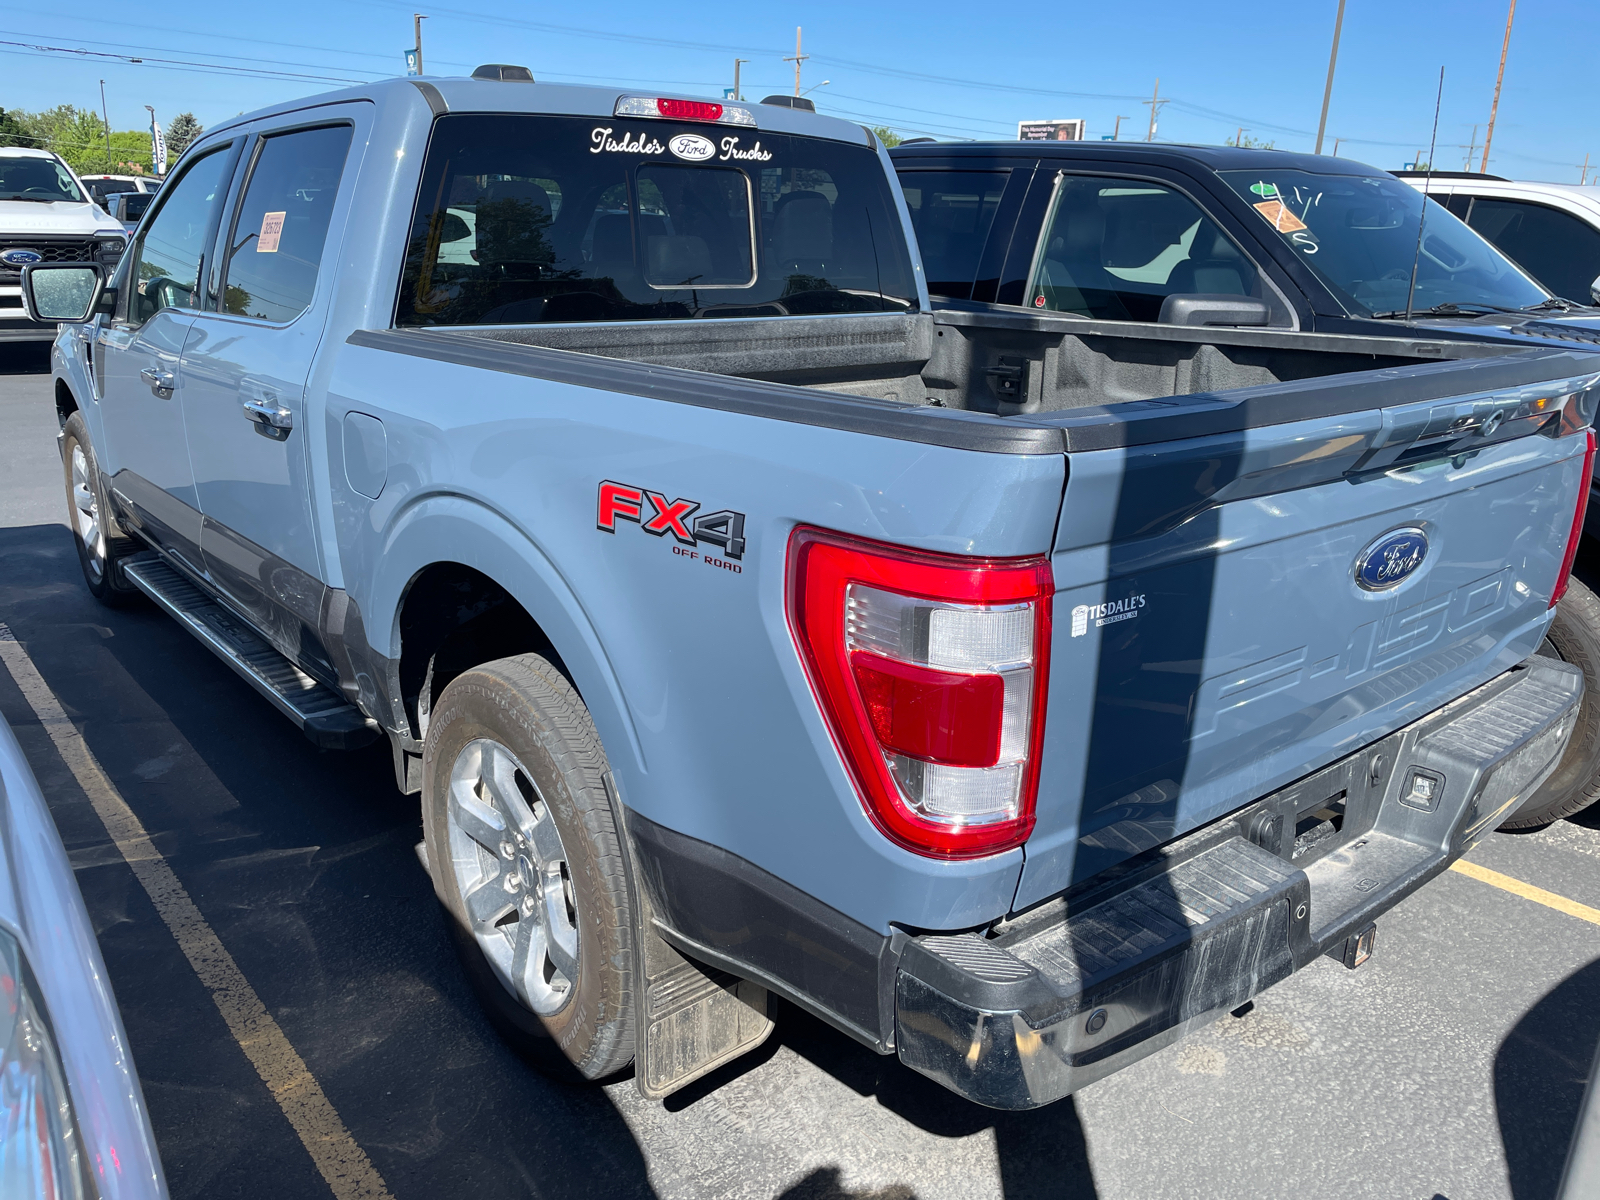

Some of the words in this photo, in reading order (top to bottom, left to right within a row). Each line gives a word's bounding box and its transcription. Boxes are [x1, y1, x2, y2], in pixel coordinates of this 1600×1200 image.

[589, 127, 666, 154] Tisdale's
[676, 138, 709, 156] Ford
[718, 136, 773, 162] Trucks
[596, 479, 746, 561] FX4
[672, 546, 700, 560] OFF
[703, 555, 743, 574] ROAD
[1375, 540, 1421, 581] Ford
[1089, 594, 1146, 620] TISDALE'S
[1183, 566, 1515, 742] F-150
